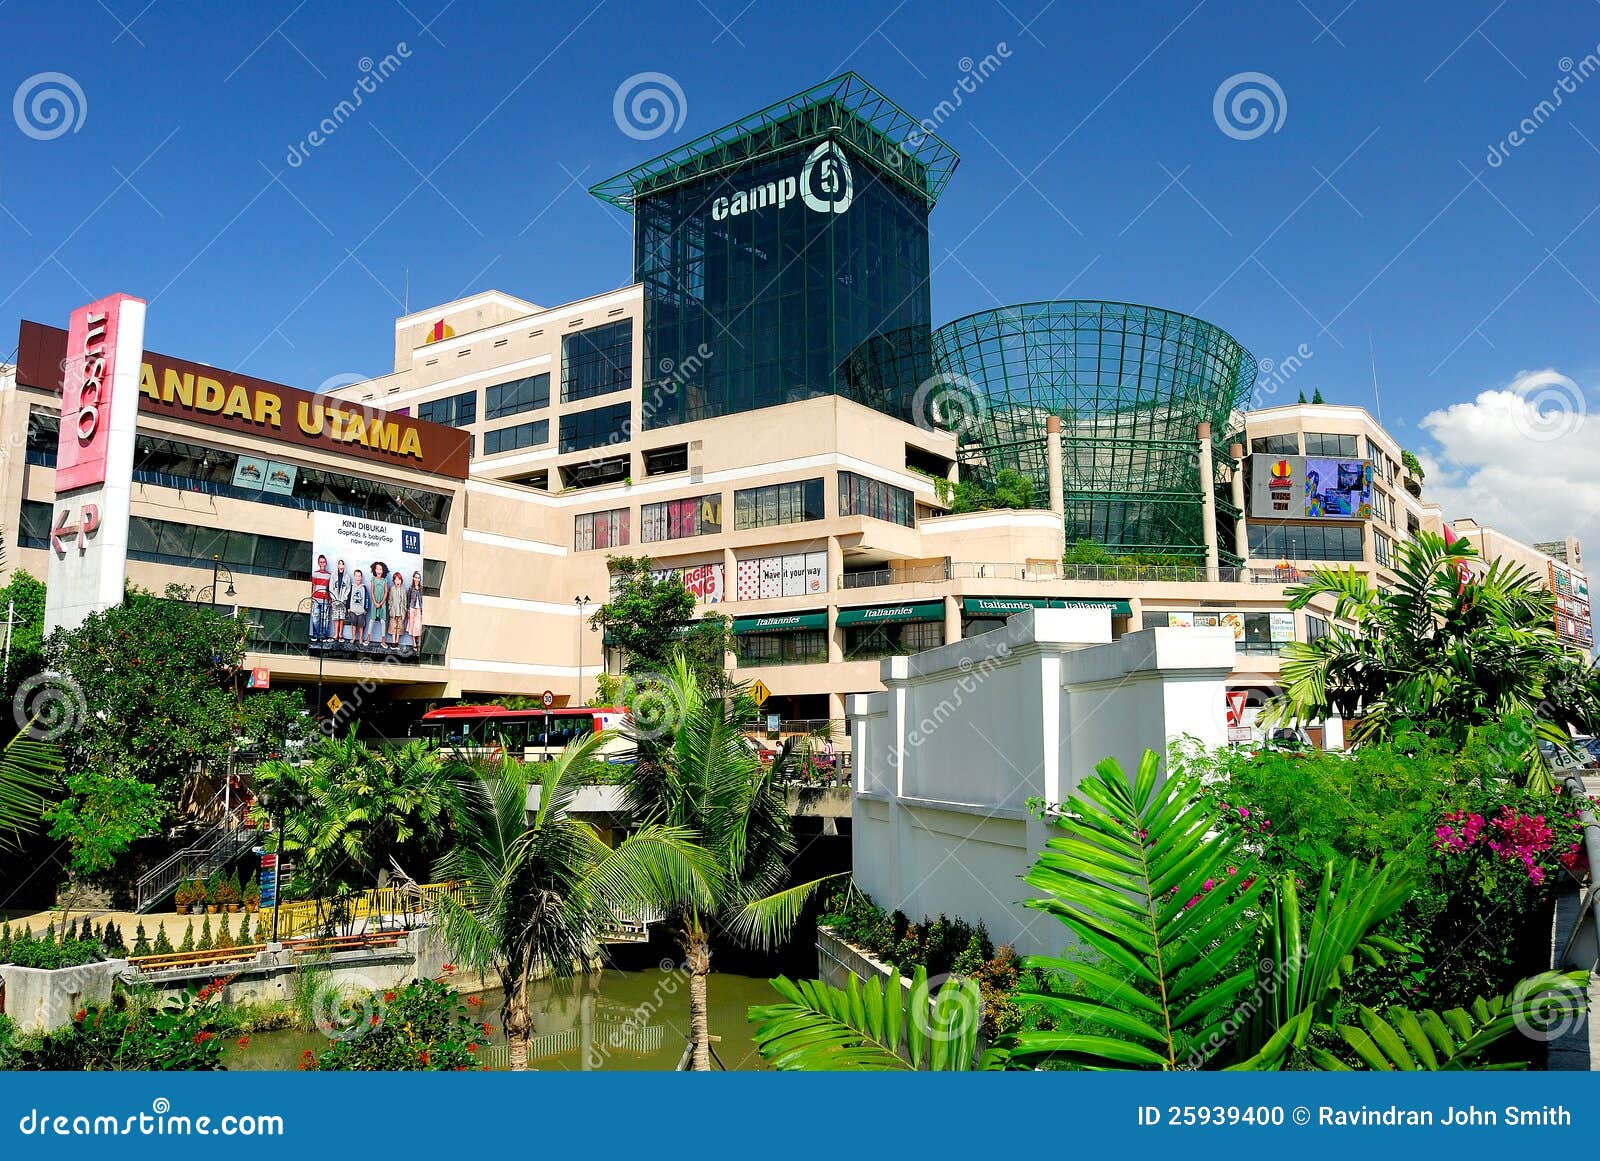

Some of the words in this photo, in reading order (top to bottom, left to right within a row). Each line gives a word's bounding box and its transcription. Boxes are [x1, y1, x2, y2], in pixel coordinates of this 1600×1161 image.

[712, 176, 797, 221] camp
[76, 311, 109, 441] JUSCO
[139, 362, 283, 428] ANDAR
[298, 400, 424, 460] UTAMA
[338, 528, 361, 538] GapKids
[368, 534, 394, 543] babyGap
[342, 520, 357, 529] KINI
[358, 523, 387, 533] DIBUKA!
[684, 564, 713, 585] RGER
[764, 571, 780, 580] Have
[783, 569, 788, 577] it
[790, 569, 804, 579] your
[807, 567, 821, 576] way
[685, 576, 716, 598] NG
[864, 607, 913, 618] Italiannies
